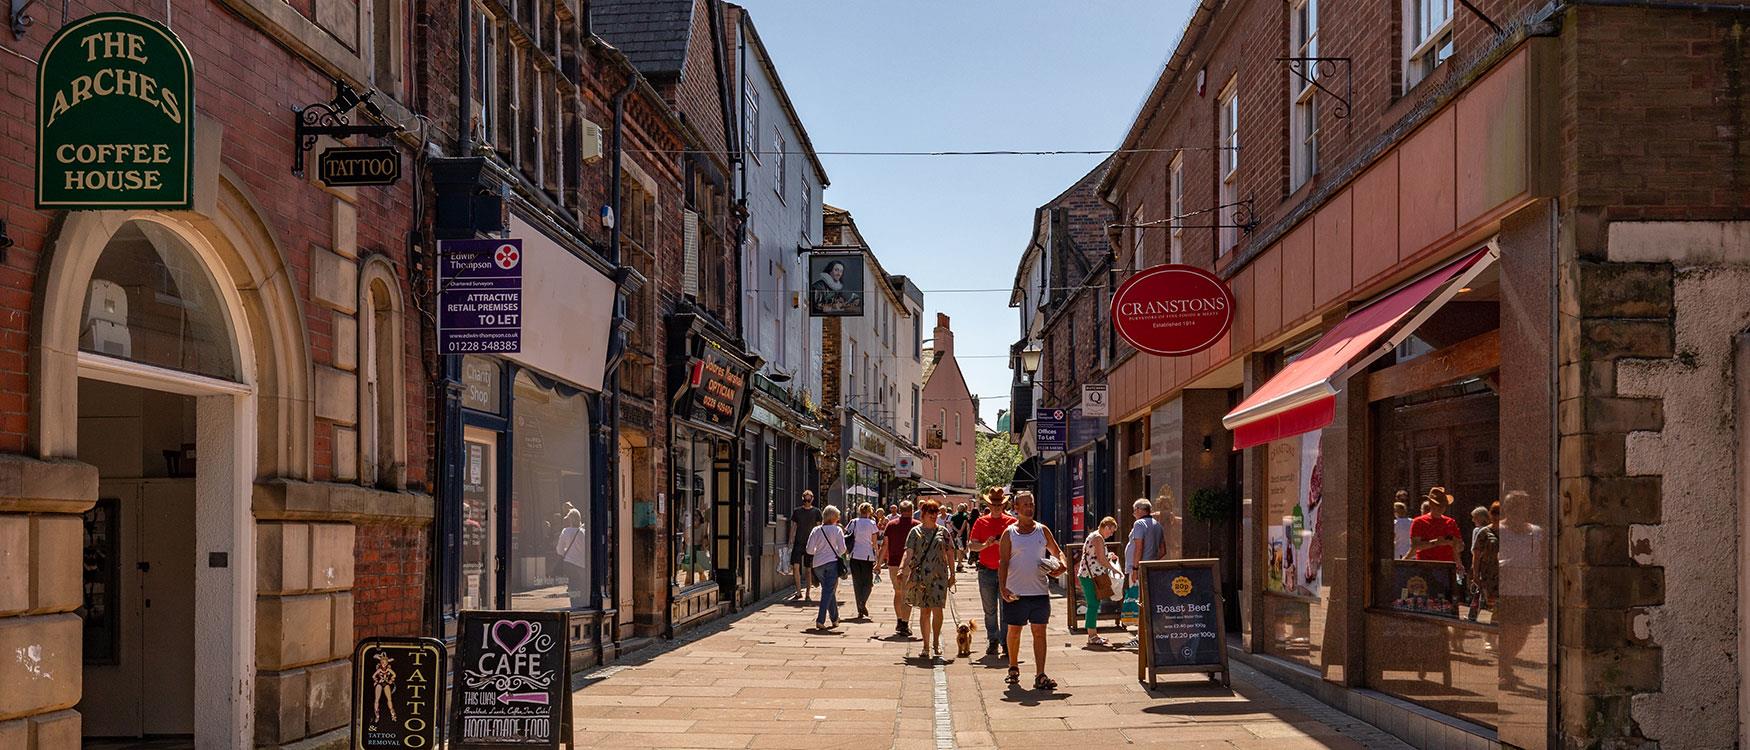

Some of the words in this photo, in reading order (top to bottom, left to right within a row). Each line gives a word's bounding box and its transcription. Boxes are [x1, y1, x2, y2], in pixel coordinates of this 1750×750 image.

[81, 32, 148, 64] THE
[47, 68, 182, 128] ARCHES
[56, 144, 171, 163] COFFEE
[326, 159, 394, 176] TATTOO
[64, 170, 163, 190] HOUSE
[467, 293, 518, 301] ATTRACTIVE
[1121, 297, 1225, 316] CRANSTONS
[478, 303, 518, 311] PREMISES
[478, 314, 495, 325] TO
[498, 314, 518, 325] LET
[1152, 321, 1182, 329] Established
[448, 342, 479, 351] 01228
[481, 341, 518, 351] 548385
[466, 363, 491, 387] Charity
[470, 385, 489, 404] Shop
[708, 379, 736, 401] OPTICIAN
[1090, 391, 1102, 404] Q
[1156, 604, 1186, 613] Roast
[1188, 603, 1211, 612] Beef
[481, 623, 489, 649] I
[1170, 631, 1188, 639] £2.20
[1189, 632, 1200, 640] per
[1200, 630, 1216, 639] 100g
[478, 653, 541, 676] CAFE
[404, 652, 427, 748] TATTOO
[464, 692, 479, 705] THIS
[480, 692, 496, 706] WAY
[464, 719, 521, 737] HOMEMADE
[524, 718, 550, 737] FOOD
